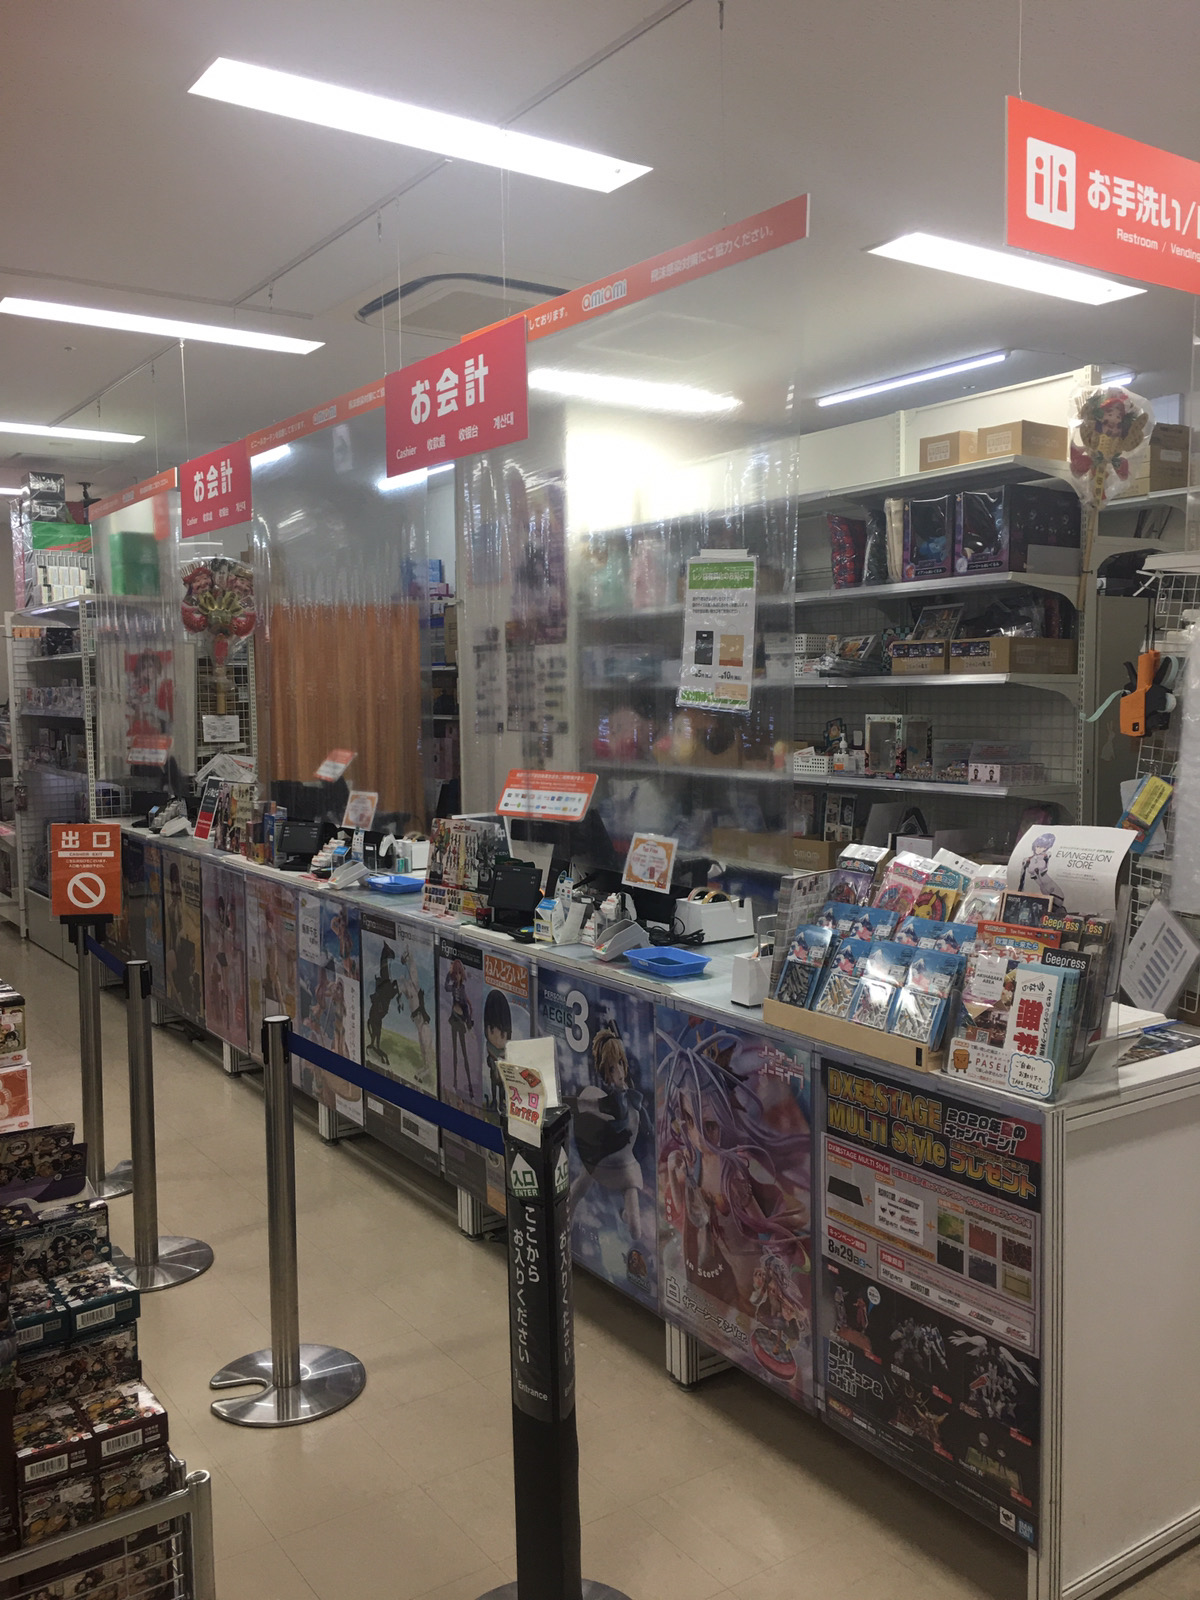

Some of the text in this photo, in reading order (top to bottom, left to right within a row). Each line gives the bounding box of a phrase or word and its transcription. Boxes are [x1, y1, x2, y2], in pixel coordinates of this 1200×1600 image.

[1087, 169, 1200, 240] お手洗い/
[1116, 228, 1159, 249] Restroom
[582, 279, 627, 312] amiami
[410, 353, 489, 425] お会計
[396, 445, 417, 460] Cashier
[193, 458, 233, 503] お会計
[61, 830, 111, 849] 出口
[1056, 850, 1113, 863] EVANGELION
[1067, 860, 1094, 870] STORE
[1042, 914, 1080, 931] Geepress
[485, 956, 528, 988] ねんどろいど
[1045, 952, 1087, 970] Geepress
[543, 1004, 573, 1027] AEGIS
[565, 990, 590, 1053] 3
[508, 1085, 540, 1109] 入口
[828, 1097, 947, 1168] MULTI Style
[512, 1169, 537, 1187] 入口
[950, 1150, 1037, 1200] プレゼント
[514, 1188, 538, 1197] ENTER
[525, 1206, 540, 1283] ここから
[513, 1229, 530, 1364] お入りください
[665, 1275, 681, 1304] 白
[518, 1379, 548, 1401] Entrance
